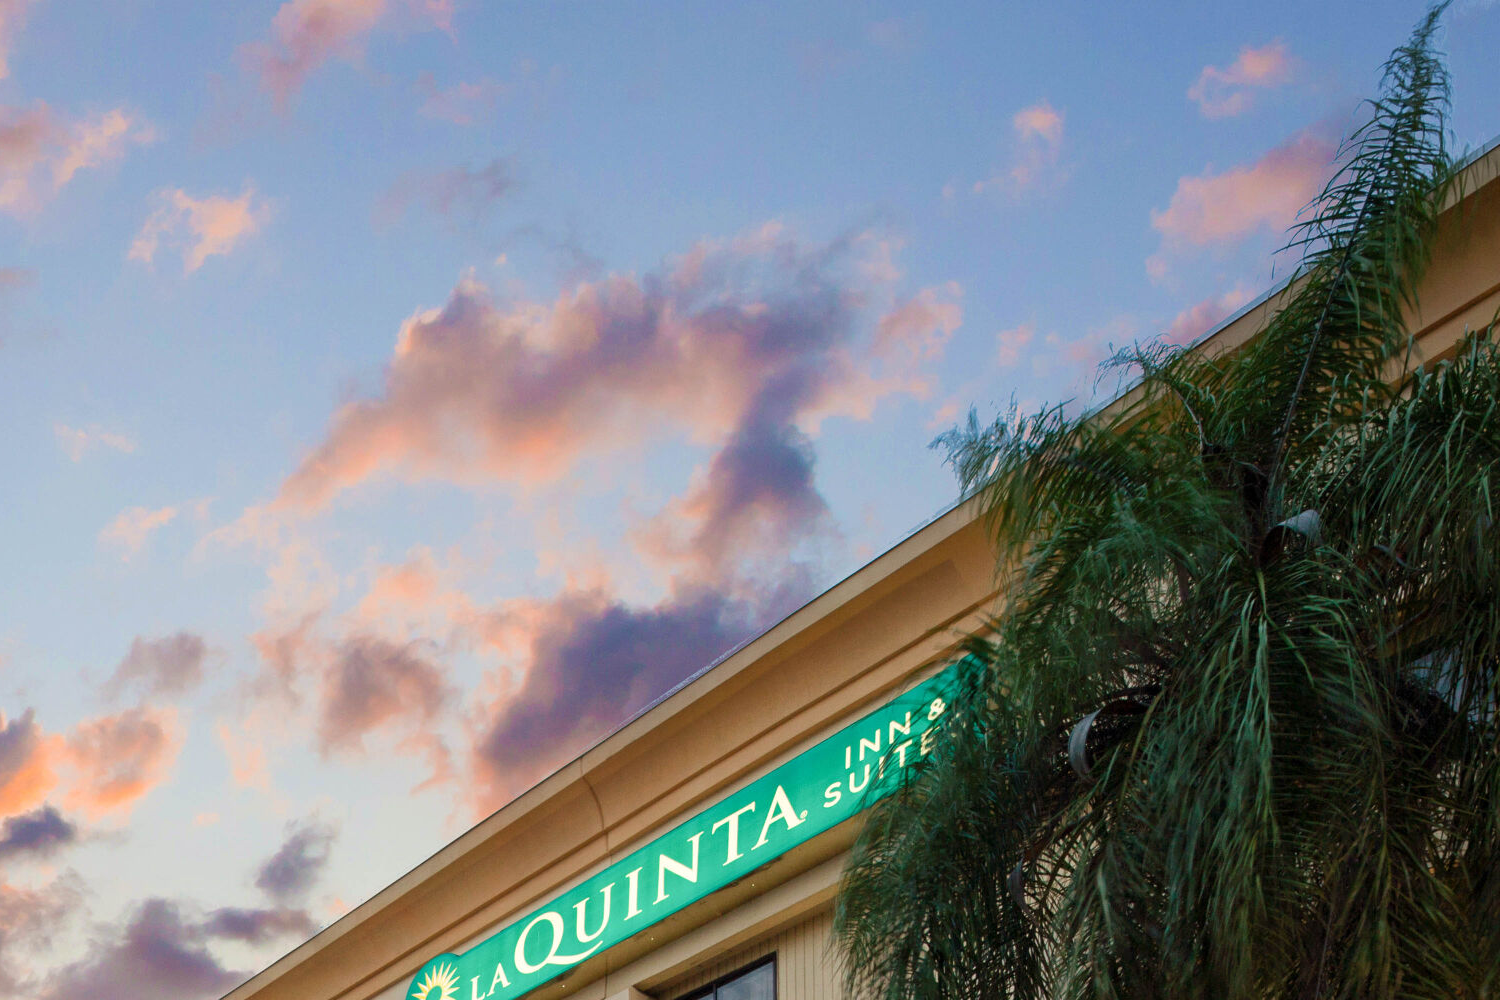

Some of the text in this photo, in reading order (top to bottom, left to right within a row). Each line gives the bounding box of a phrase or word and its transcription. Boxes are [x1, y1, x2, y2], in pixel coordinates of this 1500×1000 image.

[823, 711, 966, 808] SUITE
[845, 697, 946, 770] INN &
[513, 785, 805, 975] QUINTA
